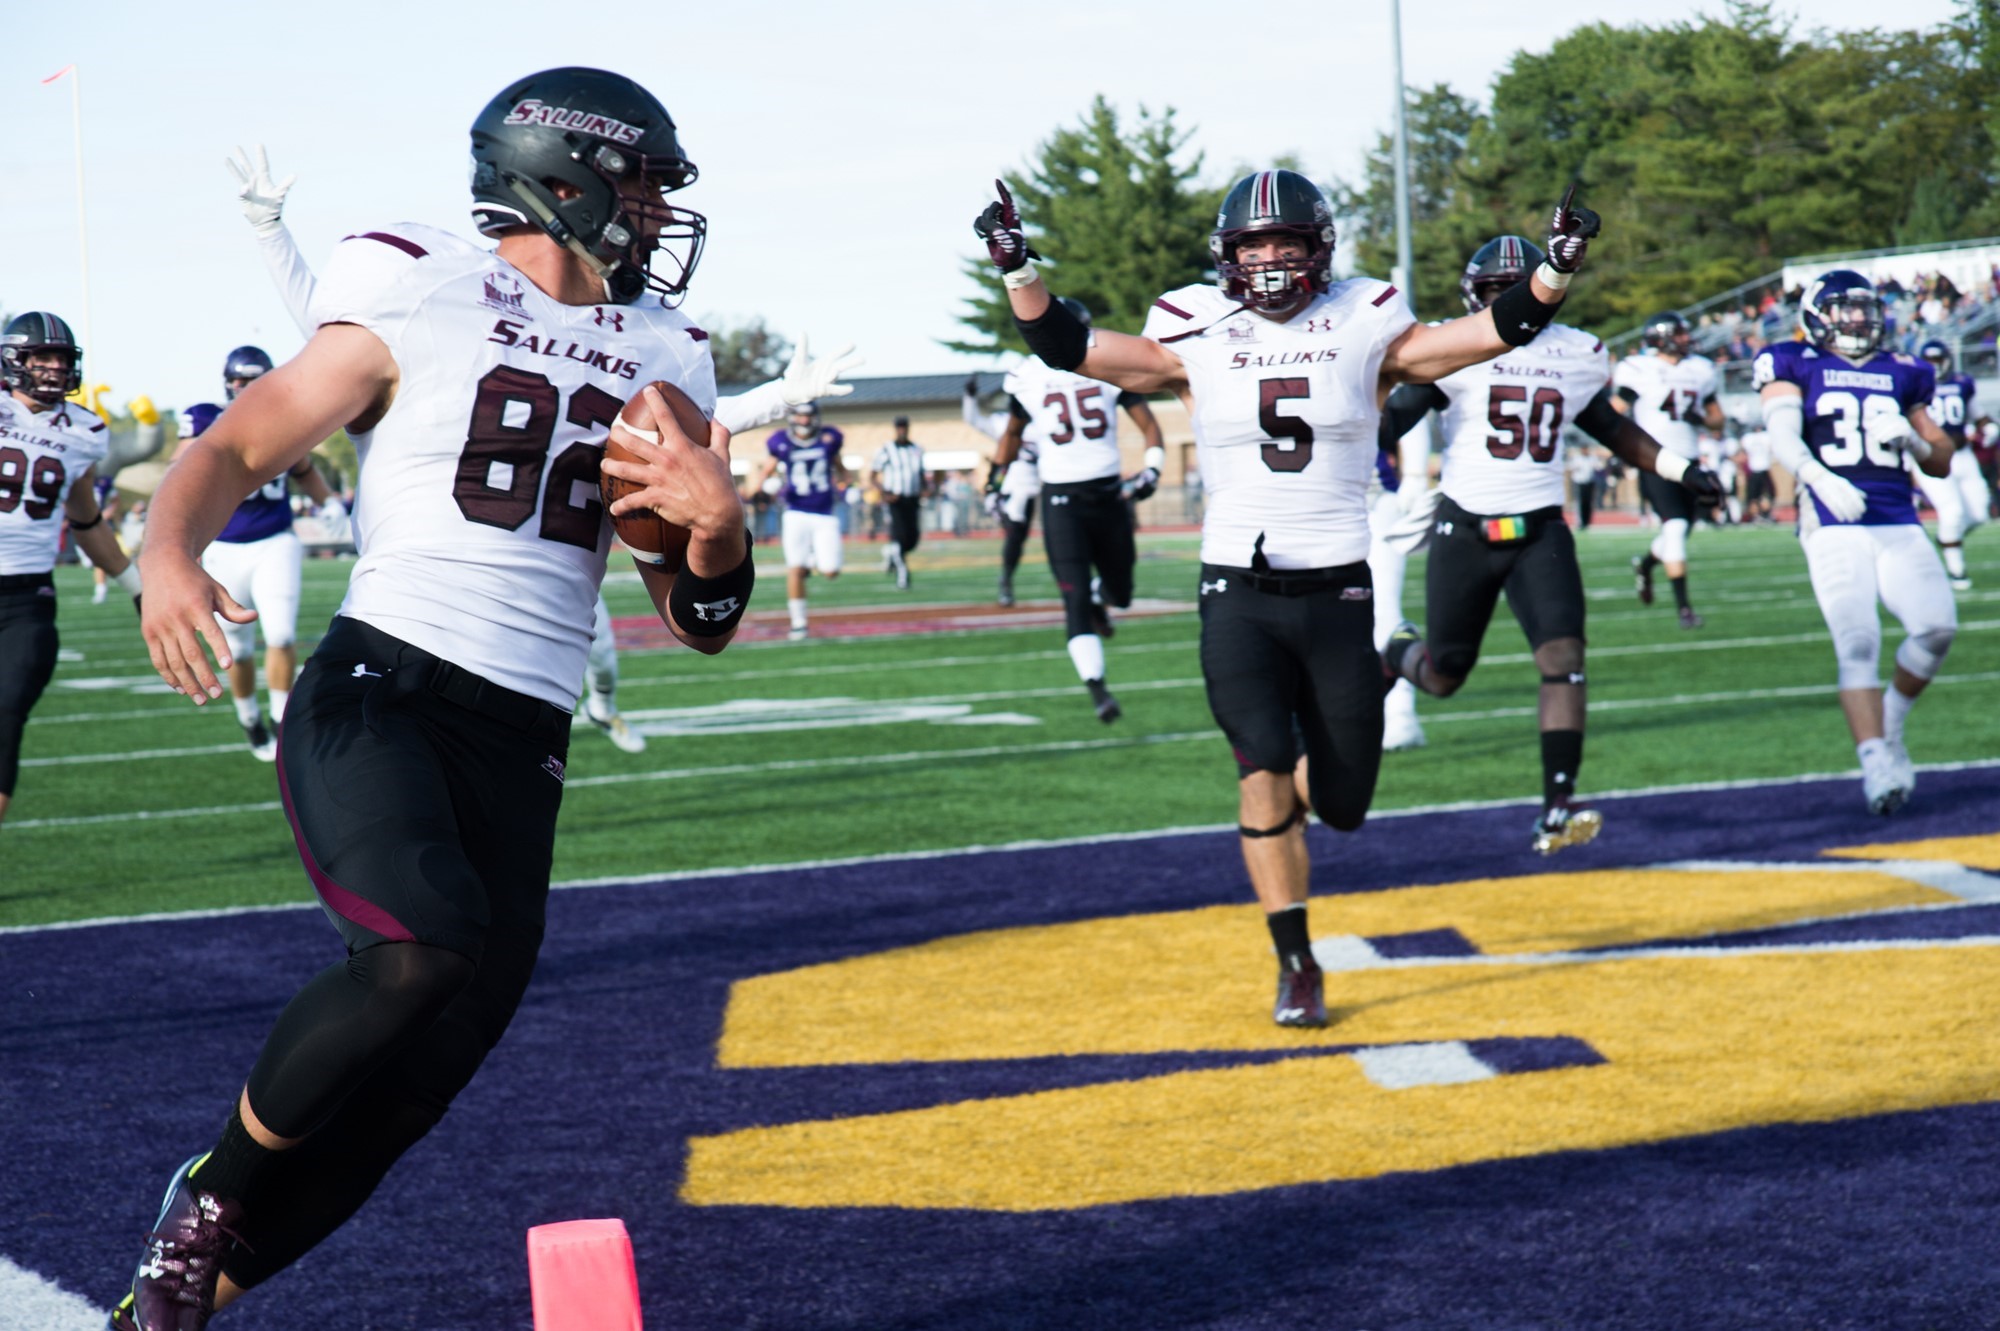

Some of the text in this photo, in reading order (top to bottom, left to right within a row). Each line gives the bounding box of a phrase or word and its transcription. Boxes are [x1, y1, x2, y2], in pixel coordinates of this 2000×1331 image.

[504, 99, 645, 145] SALUKIS
[487, 319, 642, 379] SALUKIS
[1229, 347, 1342, 369] SALUKIS
[1490, 361, 1564, 379] SALUKIS
[1043, 386, 1108, 445] 35
[1259, 377, 1314, 473] 5
[1486, 384, 1564, 463] 50
[1660, 388, 1698, 421] 47
[0, 425, 66, 452] SALUKIS
[452, 363, 625, 553] 82
[0, 446, 66, 521] 99
[791, 459, 829, 496] 44
